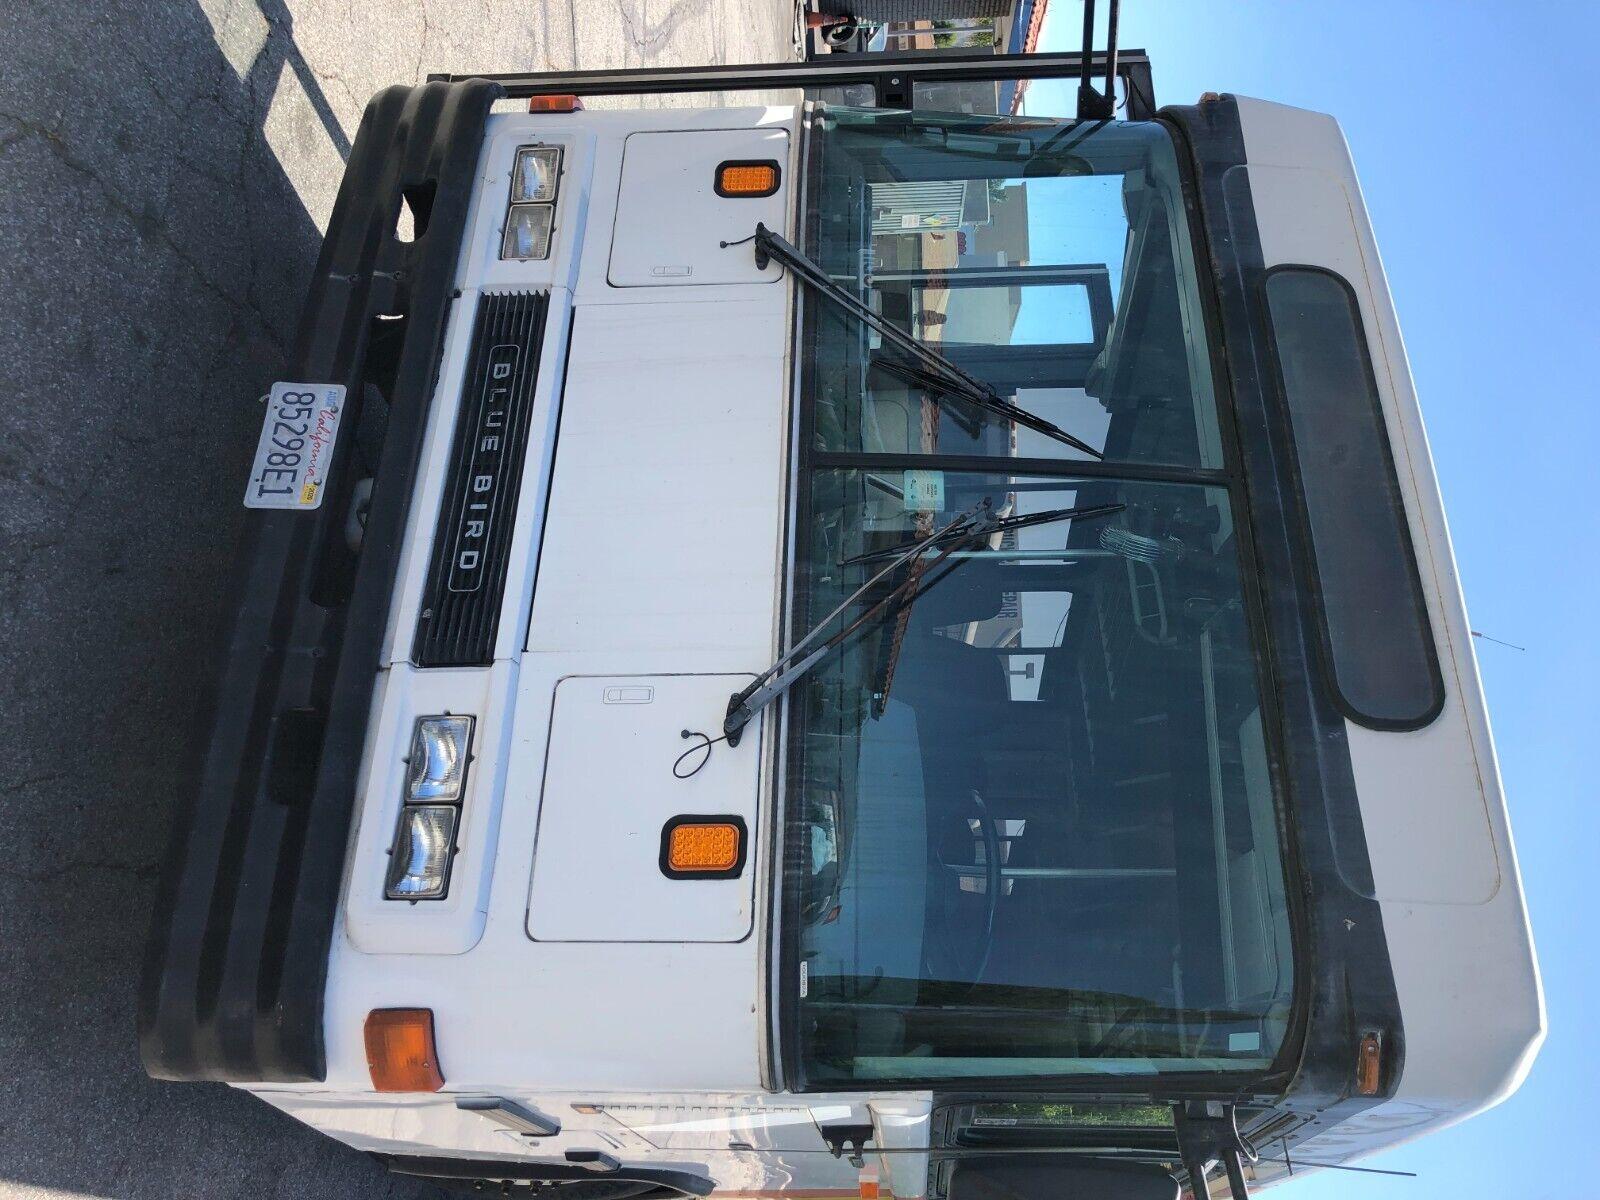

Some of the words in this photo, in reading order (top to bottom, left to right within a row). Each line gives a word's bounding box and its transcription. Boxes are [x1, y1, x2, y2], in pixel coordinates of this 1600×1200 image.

[258, 391, 316, 498] 85298E1
[304, 409, 336, 485] California
[480, 363, 511, 452] BLUE
[459, 475, 493, 569] BIRD
[998, 592, 1018, 619] EPAIR
